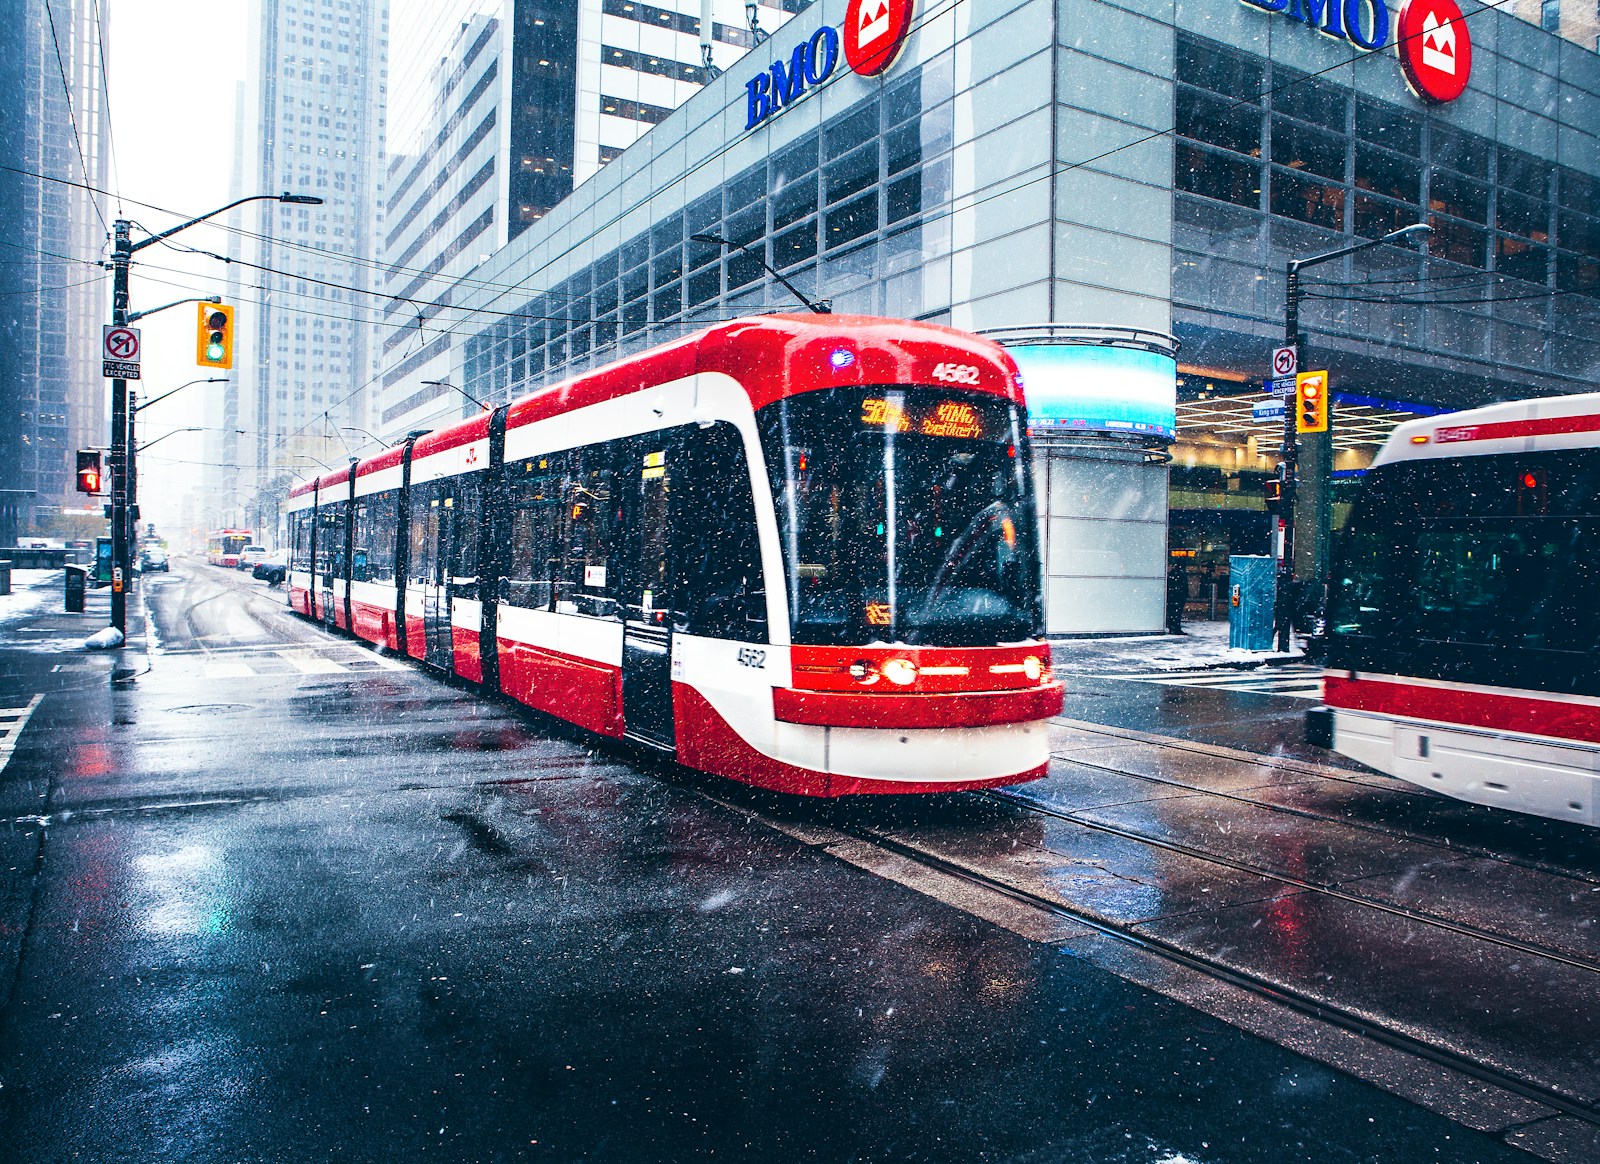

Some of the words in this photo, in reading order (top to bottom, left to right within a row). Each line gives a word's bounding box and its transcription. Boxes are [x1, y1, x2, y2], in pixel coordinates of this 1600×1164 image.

[1240, 0, 1389, 50] MO
[745, 26, 839, 130] BMO
[105, 369, 139, 378] EXCEPTED
[116, 363, 140, 371] VEHICLES
[932, 362, 980, 385] 4562
[937, 403, 975, 424] KING
[1259, 409, 1270, 417] King
[86, 474, 97, 489] 9
[737, 648, 767, 669] 4562
